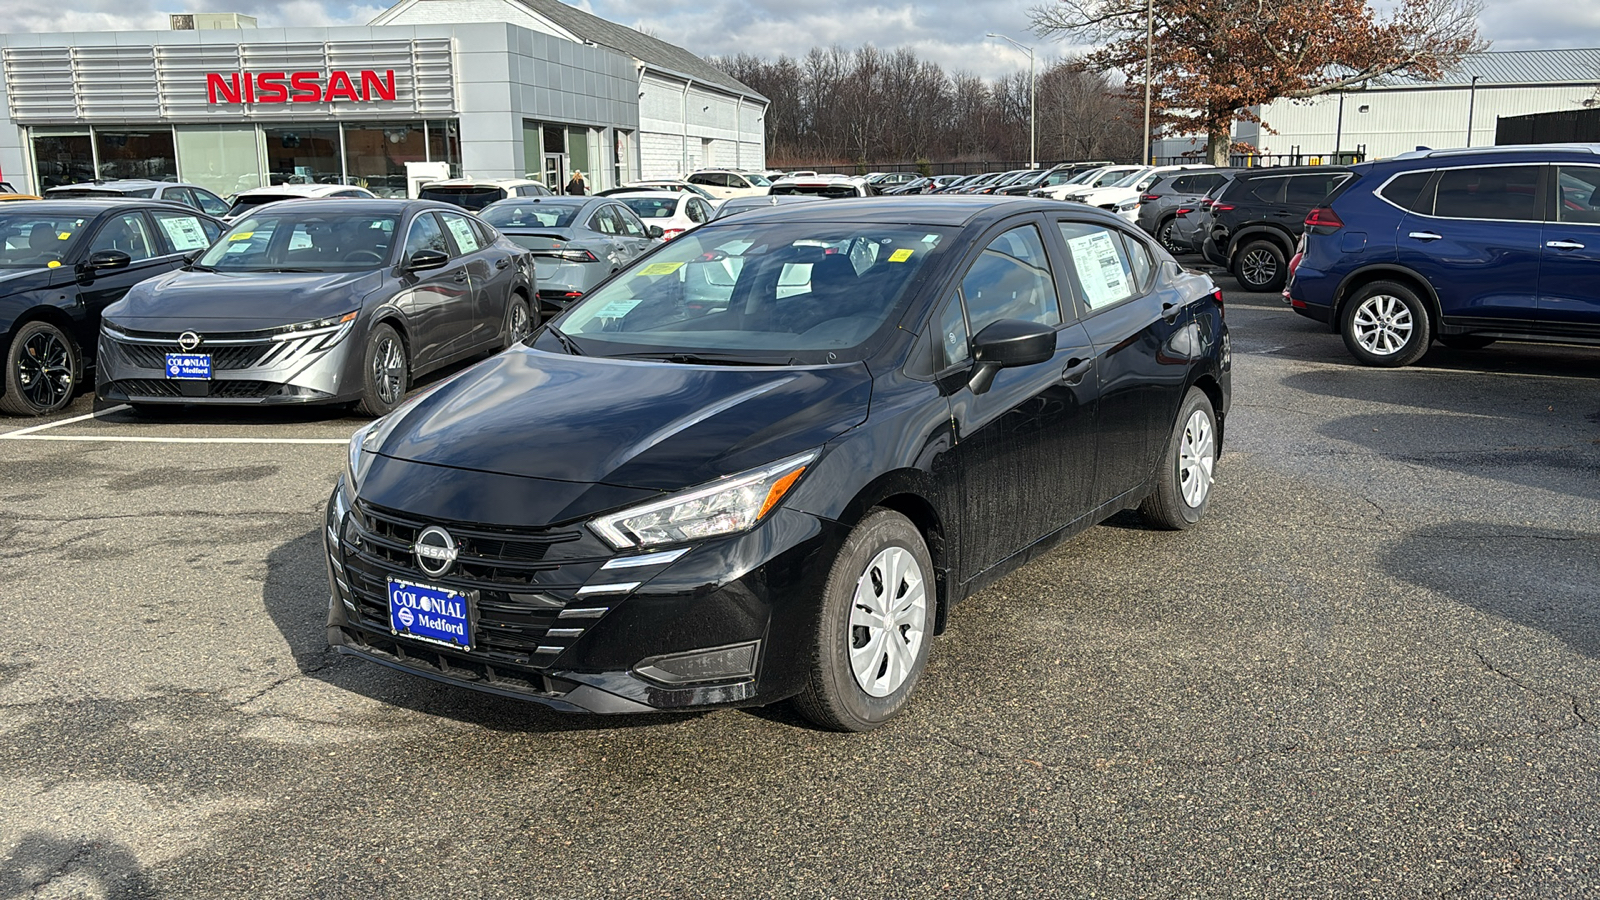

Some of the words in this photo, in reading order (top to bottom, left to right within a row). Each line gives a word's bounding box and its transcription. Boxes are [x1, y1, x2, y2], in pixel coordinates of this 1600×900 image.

[206, 69, 397, 104] NISSAN
[168, 358, 209, 367] COLONIAL
[415, 545, 456, 559] NISSAN
[393, 590, 466, 620] COLONIAL
[418, 613, 464, 636] Medford
